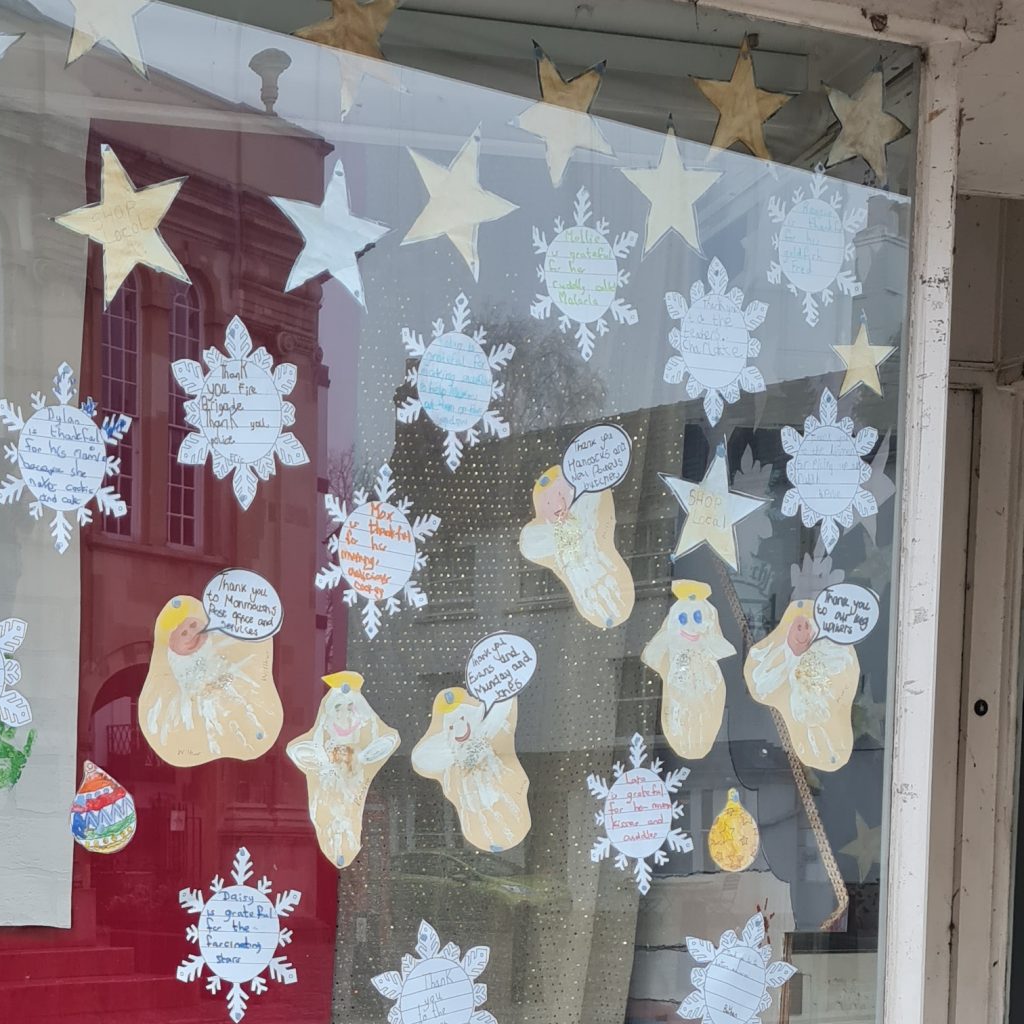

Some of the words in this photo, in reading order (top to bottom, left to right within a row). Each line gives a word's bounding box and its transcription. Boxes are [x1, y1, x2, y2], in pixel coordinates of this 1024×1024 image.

[221, 360, 248, 379] Thank
[24, 438, 42, 453] for
[574, 439, 597, 452] Thank
[71, 460, 87, 478] she
[218, 573, 247, 592] Thank
[250, 587, 268, 603] you
[207, 590, 219, 602] to
[817, 604, 828, 615] to
[257, 616, 274, 627] and
[500, 645, 521, 663] and
[511, 650, 533, 671] and
[219, 891, 254, 906] Daisy
[224, 905, 273, 922] grateful
[233, 920, 250, 932] the
